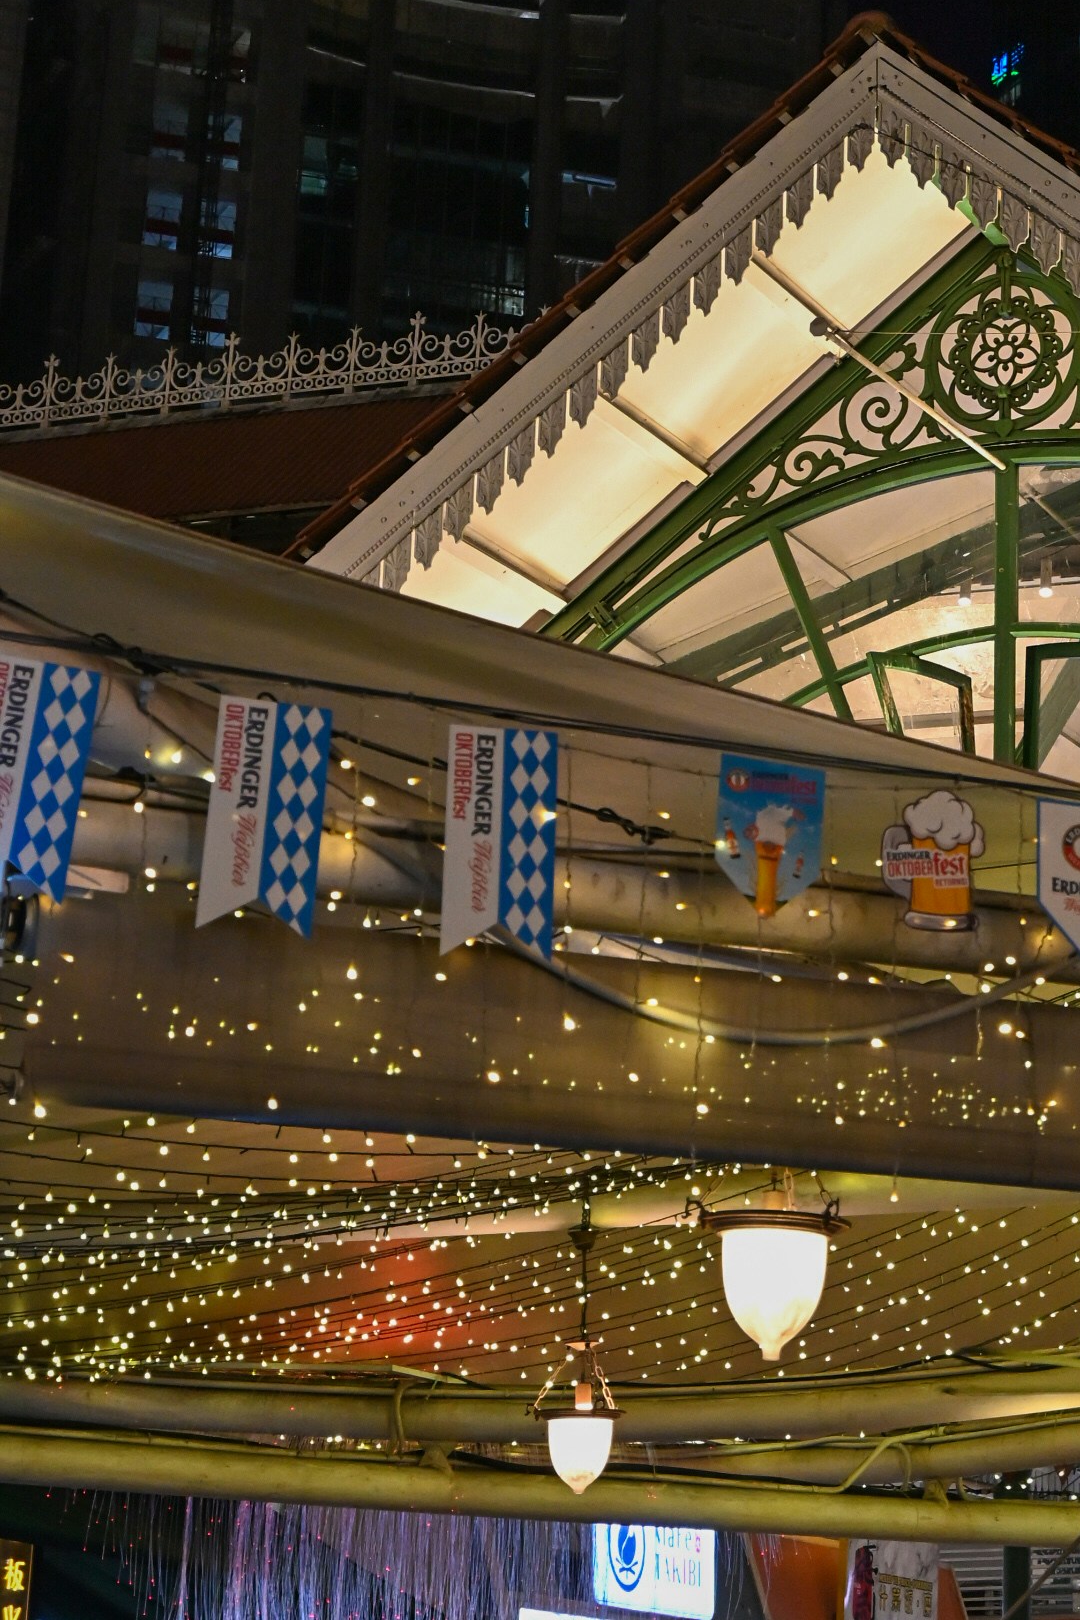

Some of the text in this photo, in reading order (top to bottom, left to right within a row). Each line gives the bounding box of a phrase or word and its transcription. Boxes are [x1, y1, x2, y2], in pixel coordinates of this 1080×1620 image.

[219, 704, 245, 793] OKTOBERfest
[236, 706, 269, 810] ERDINGER
[453, 732, 474, 820] OKTOBERfest
[471, 734, 497, 837] ERDINGER
[887, 852, 965, 877] OKTOBERfest
